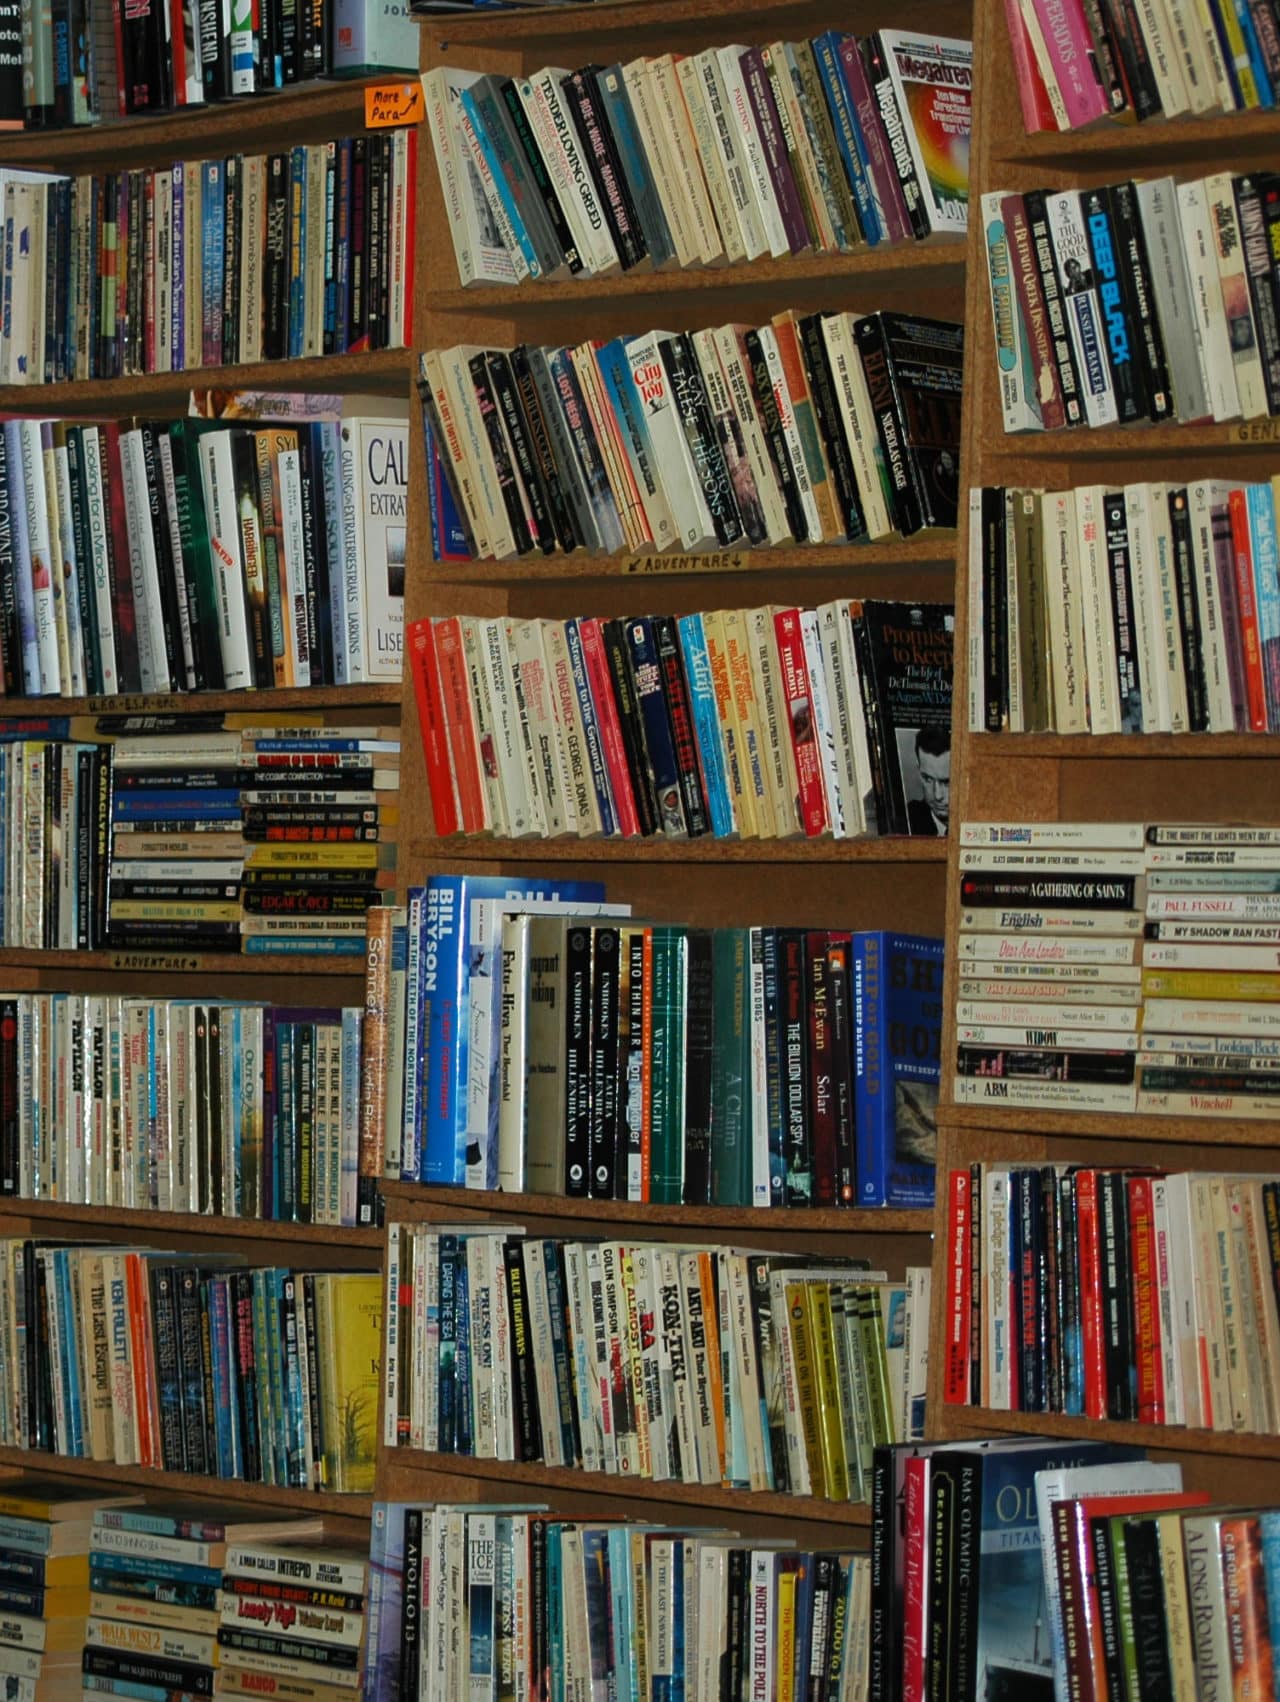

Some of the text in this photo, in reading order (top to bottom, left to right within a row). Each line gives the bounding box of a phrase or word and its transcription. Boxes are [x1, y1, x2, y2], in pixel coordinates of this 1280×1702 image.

[372, 107, 401, 121] Para
[374, 91, 400, 104] More
[874, 76, 917, 179] Megatrends
[540, 76, 603, 231] TENDER LOVING GREED
[579, 97, 622, 207] ROE WADE MARIAN
[1088, 212, 1131, 366] DEEP BLACK
[1132, 264, 1149, 319] ITALIANS
[1076, 295, 1105, 395] RUSSELL BAKER
[672, 367, 698, 427] TALESE
[879, 411, 907, 490] NICHOLAS GAGE
[84, 438, 107, 590] Looking Miracle
[149, 486, 161, 516] END
[175, 474, 193, 549] MESSAGES
[242, 517, 258, 579] HARBINGER
[342, 450, 360, 655] CALLING EXTRATERRESTRIALS LARKINS
[644, 554, 733, 572] ADVENTURE
[294, 594, 308, 664] NOSTRADAMUS
[568, 635, 603, 772] Stranger Ground
[689, 645, 715, 701] Adrift
[554, 658, 590, 817] VENGEANCE GEORGE JONAS
[97, 764, 108, 857] CATACLYSM
[262, 895, 295, 910] EDGAR
[438, 888, 454, 941] BILL
[1036, 881, 1126, 899] GATHERING SAINTS
[1164, 901, 1235, 912] PAUL FUSSELL
[123, 958, 187, 970] ADVENTURE
[365, 936, 383, 1016] Sonnet
[424, 888, 438, 993] BRYSON
[501, 949, 516, 1028] Fatu-Hiva
[599, 970, 610, 1040] UNBROKEN
[631, 945, 642, 1047] INTO THIN AIR
[813, 956, 827, 1051] Ian McEwan
[72, 1019, 82, 1093] PAPILLON
[93, 1026, 103, 1100] PAPILLON
[177, 1031, 186, 1096] SERPENTINE
[405, 949, 417, 1125] THE TEETH THE NORTHEASTER
[1025, 1031, 1058, 1046] WIDOW
[787, 1022, 804, 1146] THE BILLION DOLLAR SPY
[815, 1074, 830, 1116] Solar
[983, 1082, 1009, 1098] ABM
[1189, 1096, 1233, 1110] Winchell
[300, 1045, 310, 1206] THE WHITE NILE ALAN MOOREHEAD
[329, 1047, 339, 1211] THE BLUE NILE ALAN MOOREHEAD
[111, 1280, 127, 1361] KEN FOLLETT
[442, 1262, 454, 1340] DARING THE SEA
[481, 1286, 491, 1369] PRESS ON!
[509, 1267, 526, 1357] BLUE HIGHWAYS
[603, 1249, 617, 1334] COLIN SIMPSON
[686, 1286, 704, 1349] AKU-AKU
[91, 1283, 109, 1391] The Last Escape
[626, 1287, 644, 1398] ALMOST LOST
[661, 1283, 686, 1384] KON-TIKI
[278, 1557, 312, 1579] INTREPID
[934, 1489, 946, 1585] SEABISCUIT
[239, 1601, 298, 1628] Lonely Vigil
[404, 1543, 417, 1642] APOLLO 13
[1095, 1528, 1116, 1658] AUGUSTEN BURROUGHS
[755, 1585, 769, 1701] NORTH TO THE POLE
